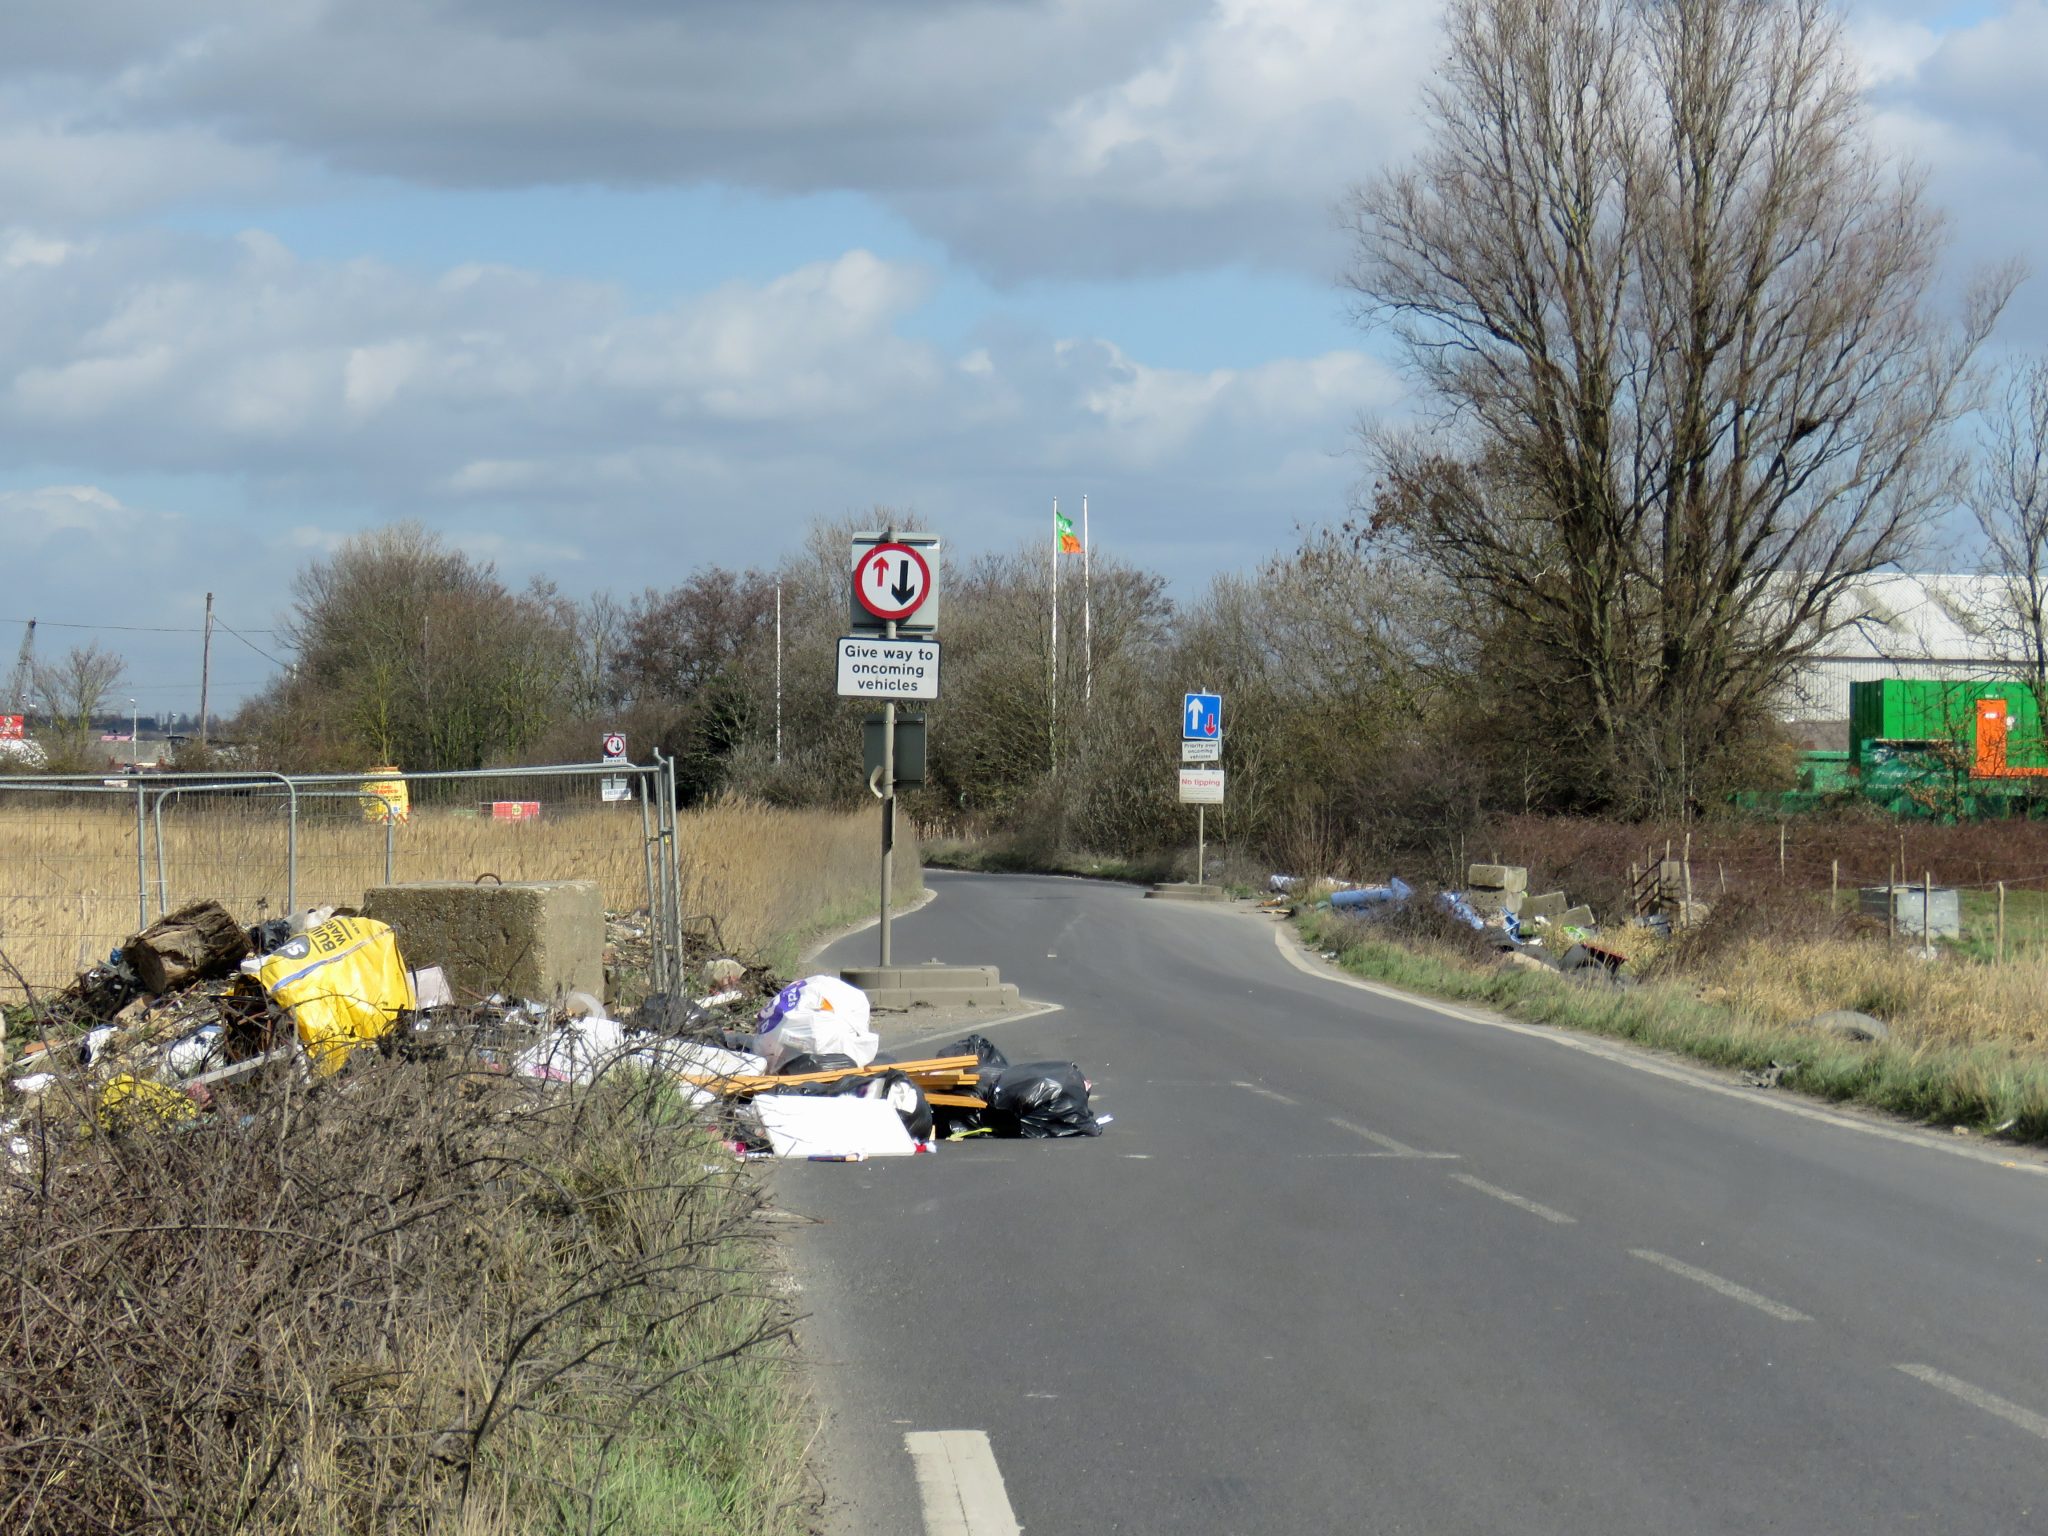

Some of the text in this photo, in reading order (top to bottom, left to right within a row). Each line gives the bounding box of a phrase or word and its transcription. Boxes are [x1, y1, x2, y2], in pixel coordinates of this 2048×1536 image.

[845, 645, 934, 662] Give way to
[852, 663, 924, 678] oncoming
[857, 678, 918, 691] vehicles
[1194, 778, 1221, 787] tipping
